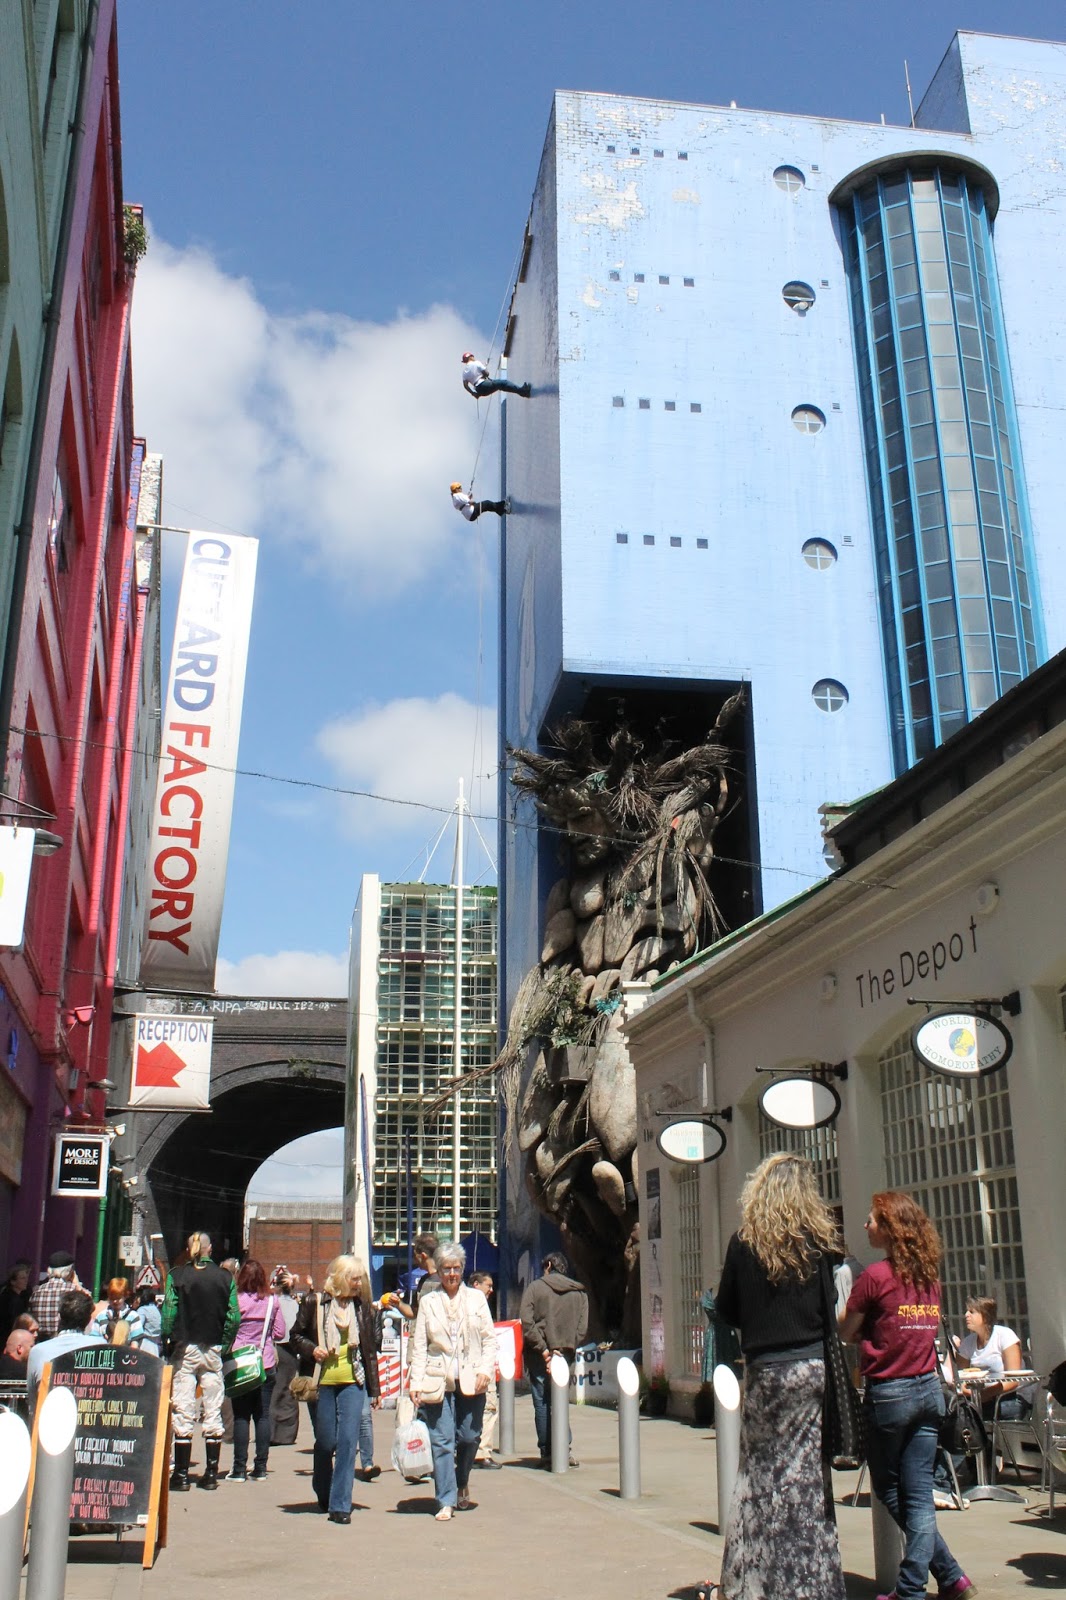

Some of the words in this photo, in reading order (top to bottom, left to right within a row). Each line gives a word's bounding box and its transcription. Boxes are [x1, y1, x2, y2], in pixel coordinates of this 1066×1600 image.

[173, 538, 231, 711] CUARD
[148, 721, 210, 956] FACTORY
[856, 968, 895, 1008] The
[900, 915, 978, 988] Depot
[138, 1020, 208, 1043] RECEPTION
[932, 1016, 970, 1029] WORLD
[975, 1018, 990, 1030] OF
[923, 1045, 1002, 1070] HOMOEOPATHY
[65, 1148, 99, 1158] MORE
[97, 1350, 116, 1368] CAFE
